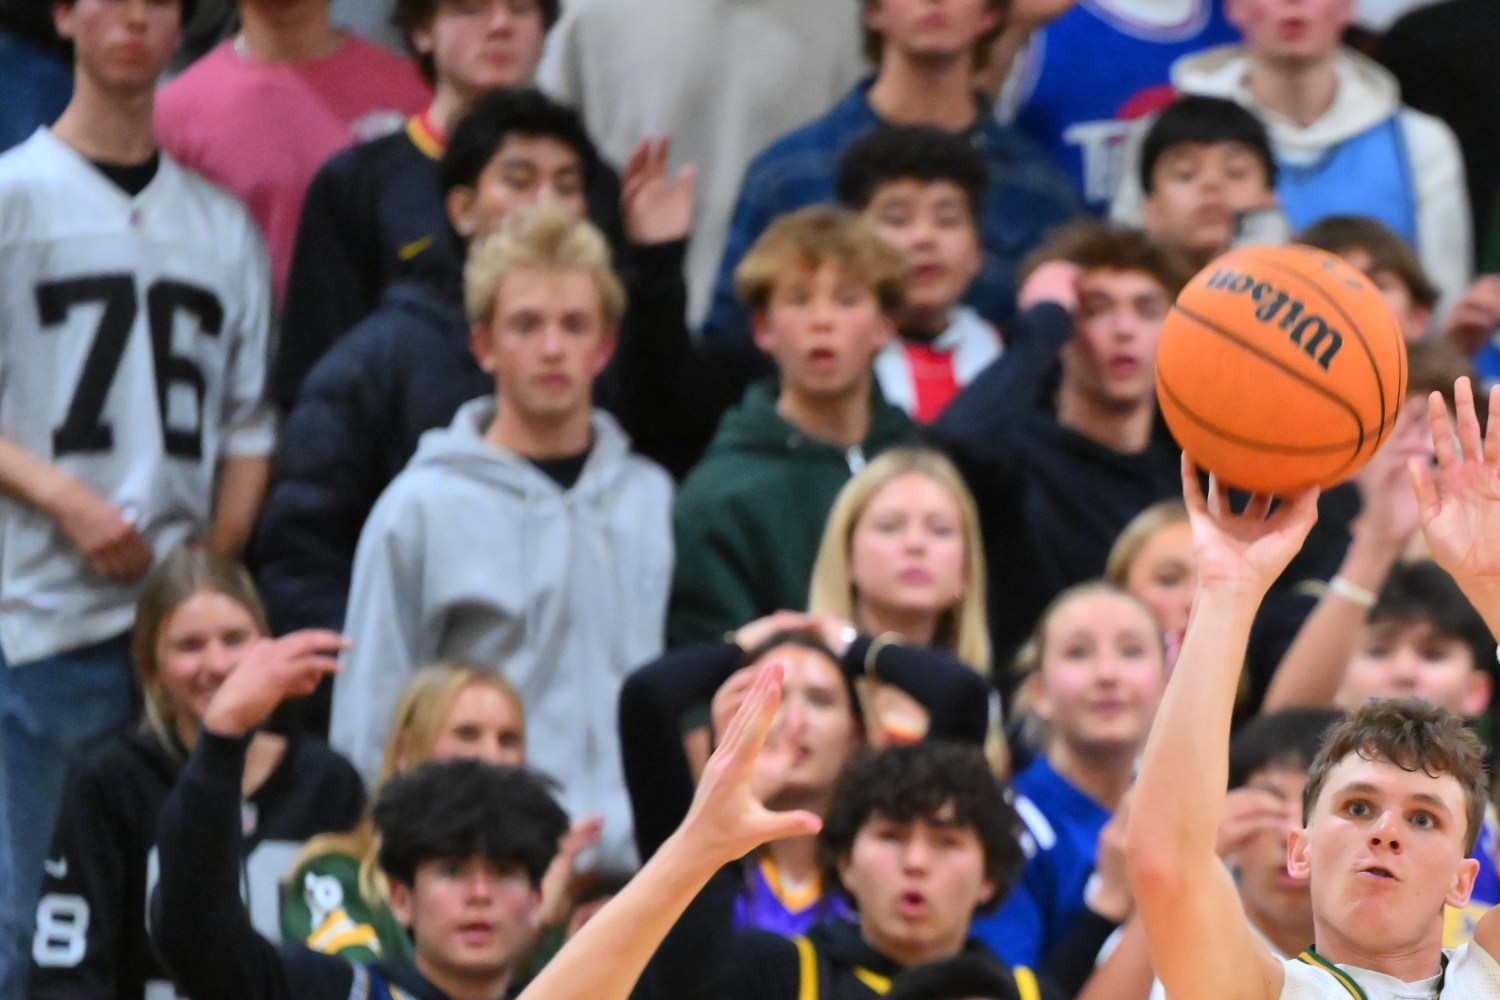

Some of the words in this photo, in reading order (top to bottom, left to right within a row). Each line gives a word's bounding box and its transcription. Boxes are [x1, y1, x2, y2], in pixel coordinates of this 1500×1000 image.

[36, 272, 224, 462] 76
[1207, 267, 1343, 371] Wilson
[32, 894, 90, 968] 8
